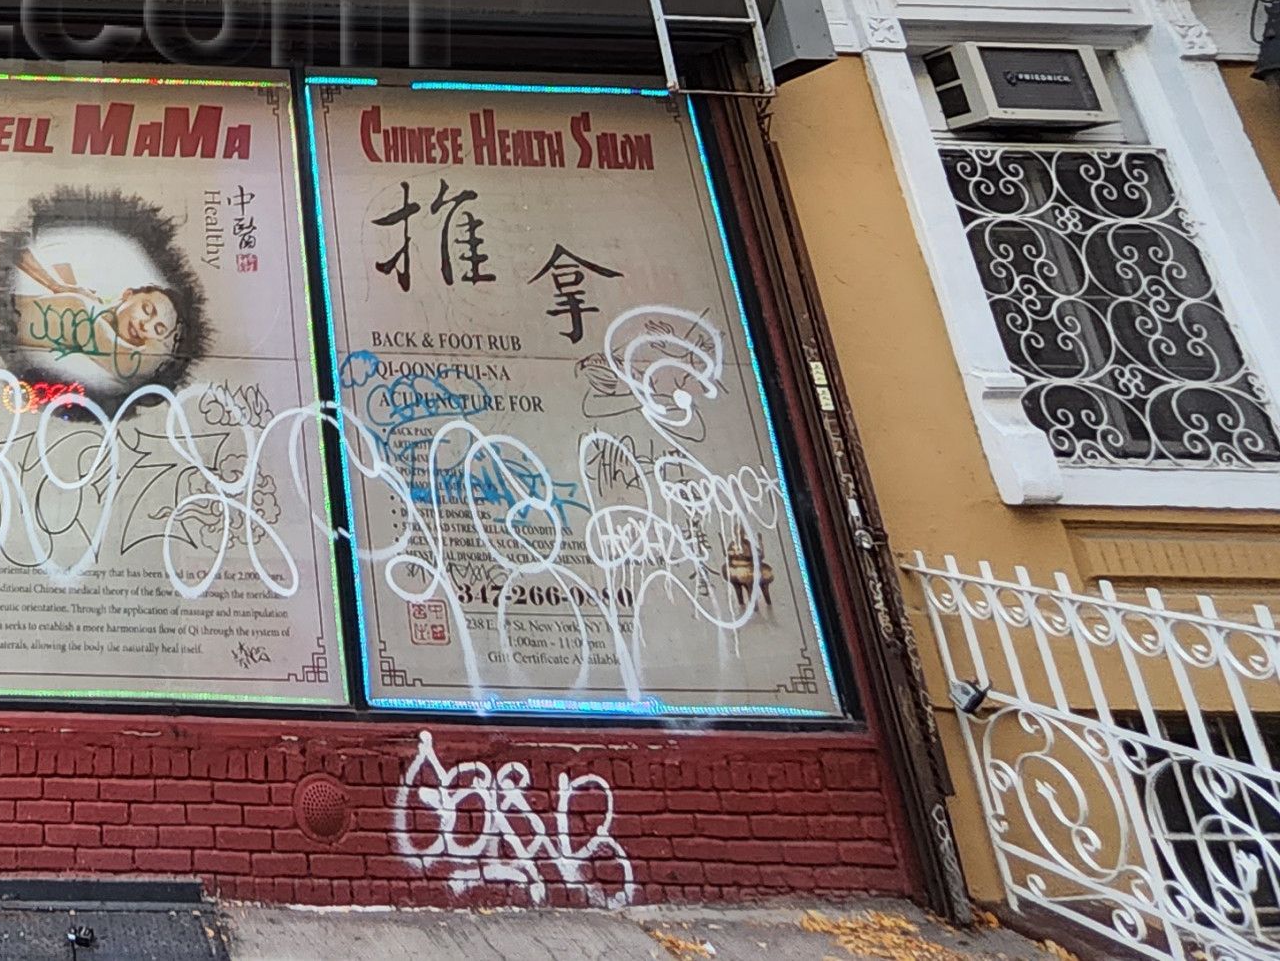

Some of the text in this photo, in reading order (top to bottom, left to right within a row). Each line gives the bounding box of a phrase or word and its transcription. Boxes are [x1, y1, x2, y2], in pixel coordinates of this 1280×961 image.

[360, 105, 654, 171] CHINESE HEALTH SALON
[201, 190, 224, 269] Healthy
[372, 331, 521, 351] BACK & FOOT RUB
[451, 365, 512, 381] TUI-NA
[509, 395, 545, 412] FOR
[523, 525, 574, 536] CONDITINS
[79, 568, 106, 578] erapy
[109, 568, 125, 577] that
[127, 568, 141, 577] has
[142, 568, 162, 578] been
[186, 569, 195, 579] in
[224, 570, 235, 581] for
[33, 584, 66, 595] Chinese
[68, 584, 100, 595] medical
[102, 586, 129, 598] theory
[130, 586, 139, 596] of
[140, 586, 154, 596] the
[155, 587, 173, 597] flow
[231, 589, 244, 599] the
[71, 604, 107, 616] Through
[108, 604, 121, 614] the
[123, 605, 168, 618] application
[169, 606, 179, 616] of
[180, 607, 215, 619] massage
[216, 607, 231, 617] and
[233, 607, 289, 620] manipulation
[4, 621, 27, 630] seeks
[28, 622, 37, 631] to
[38, 621, 74, 632] establish
[76, 624, 81, 632] a
[82, 624, 105, 633] more
[106, 623, 157, 634] harmonious
[158, 624, 176, 634] flow
[177, 625, 186, 635] of
[201, 626, 234, 638] through
[236, 626, 249, 636] the
[251, 627, 280, 639] system
[281, 626, 291, 637] of
[465, 618, 484, 630] 238
[528, 620, 553, 632] New
[30, 639, 66, 653] allowing
[68, 640, 82, 650] the
[83, 641, 104, 655] body
[107, 641, 120, 652] the
[122, 642, 159, 655] naturally
[161, 643, 179, 653] heal
[559, 637, 606, 651] 11:0pm
[512, 651, 569, 664] Certificate
[572, 653, 624, 666] Aailabl
